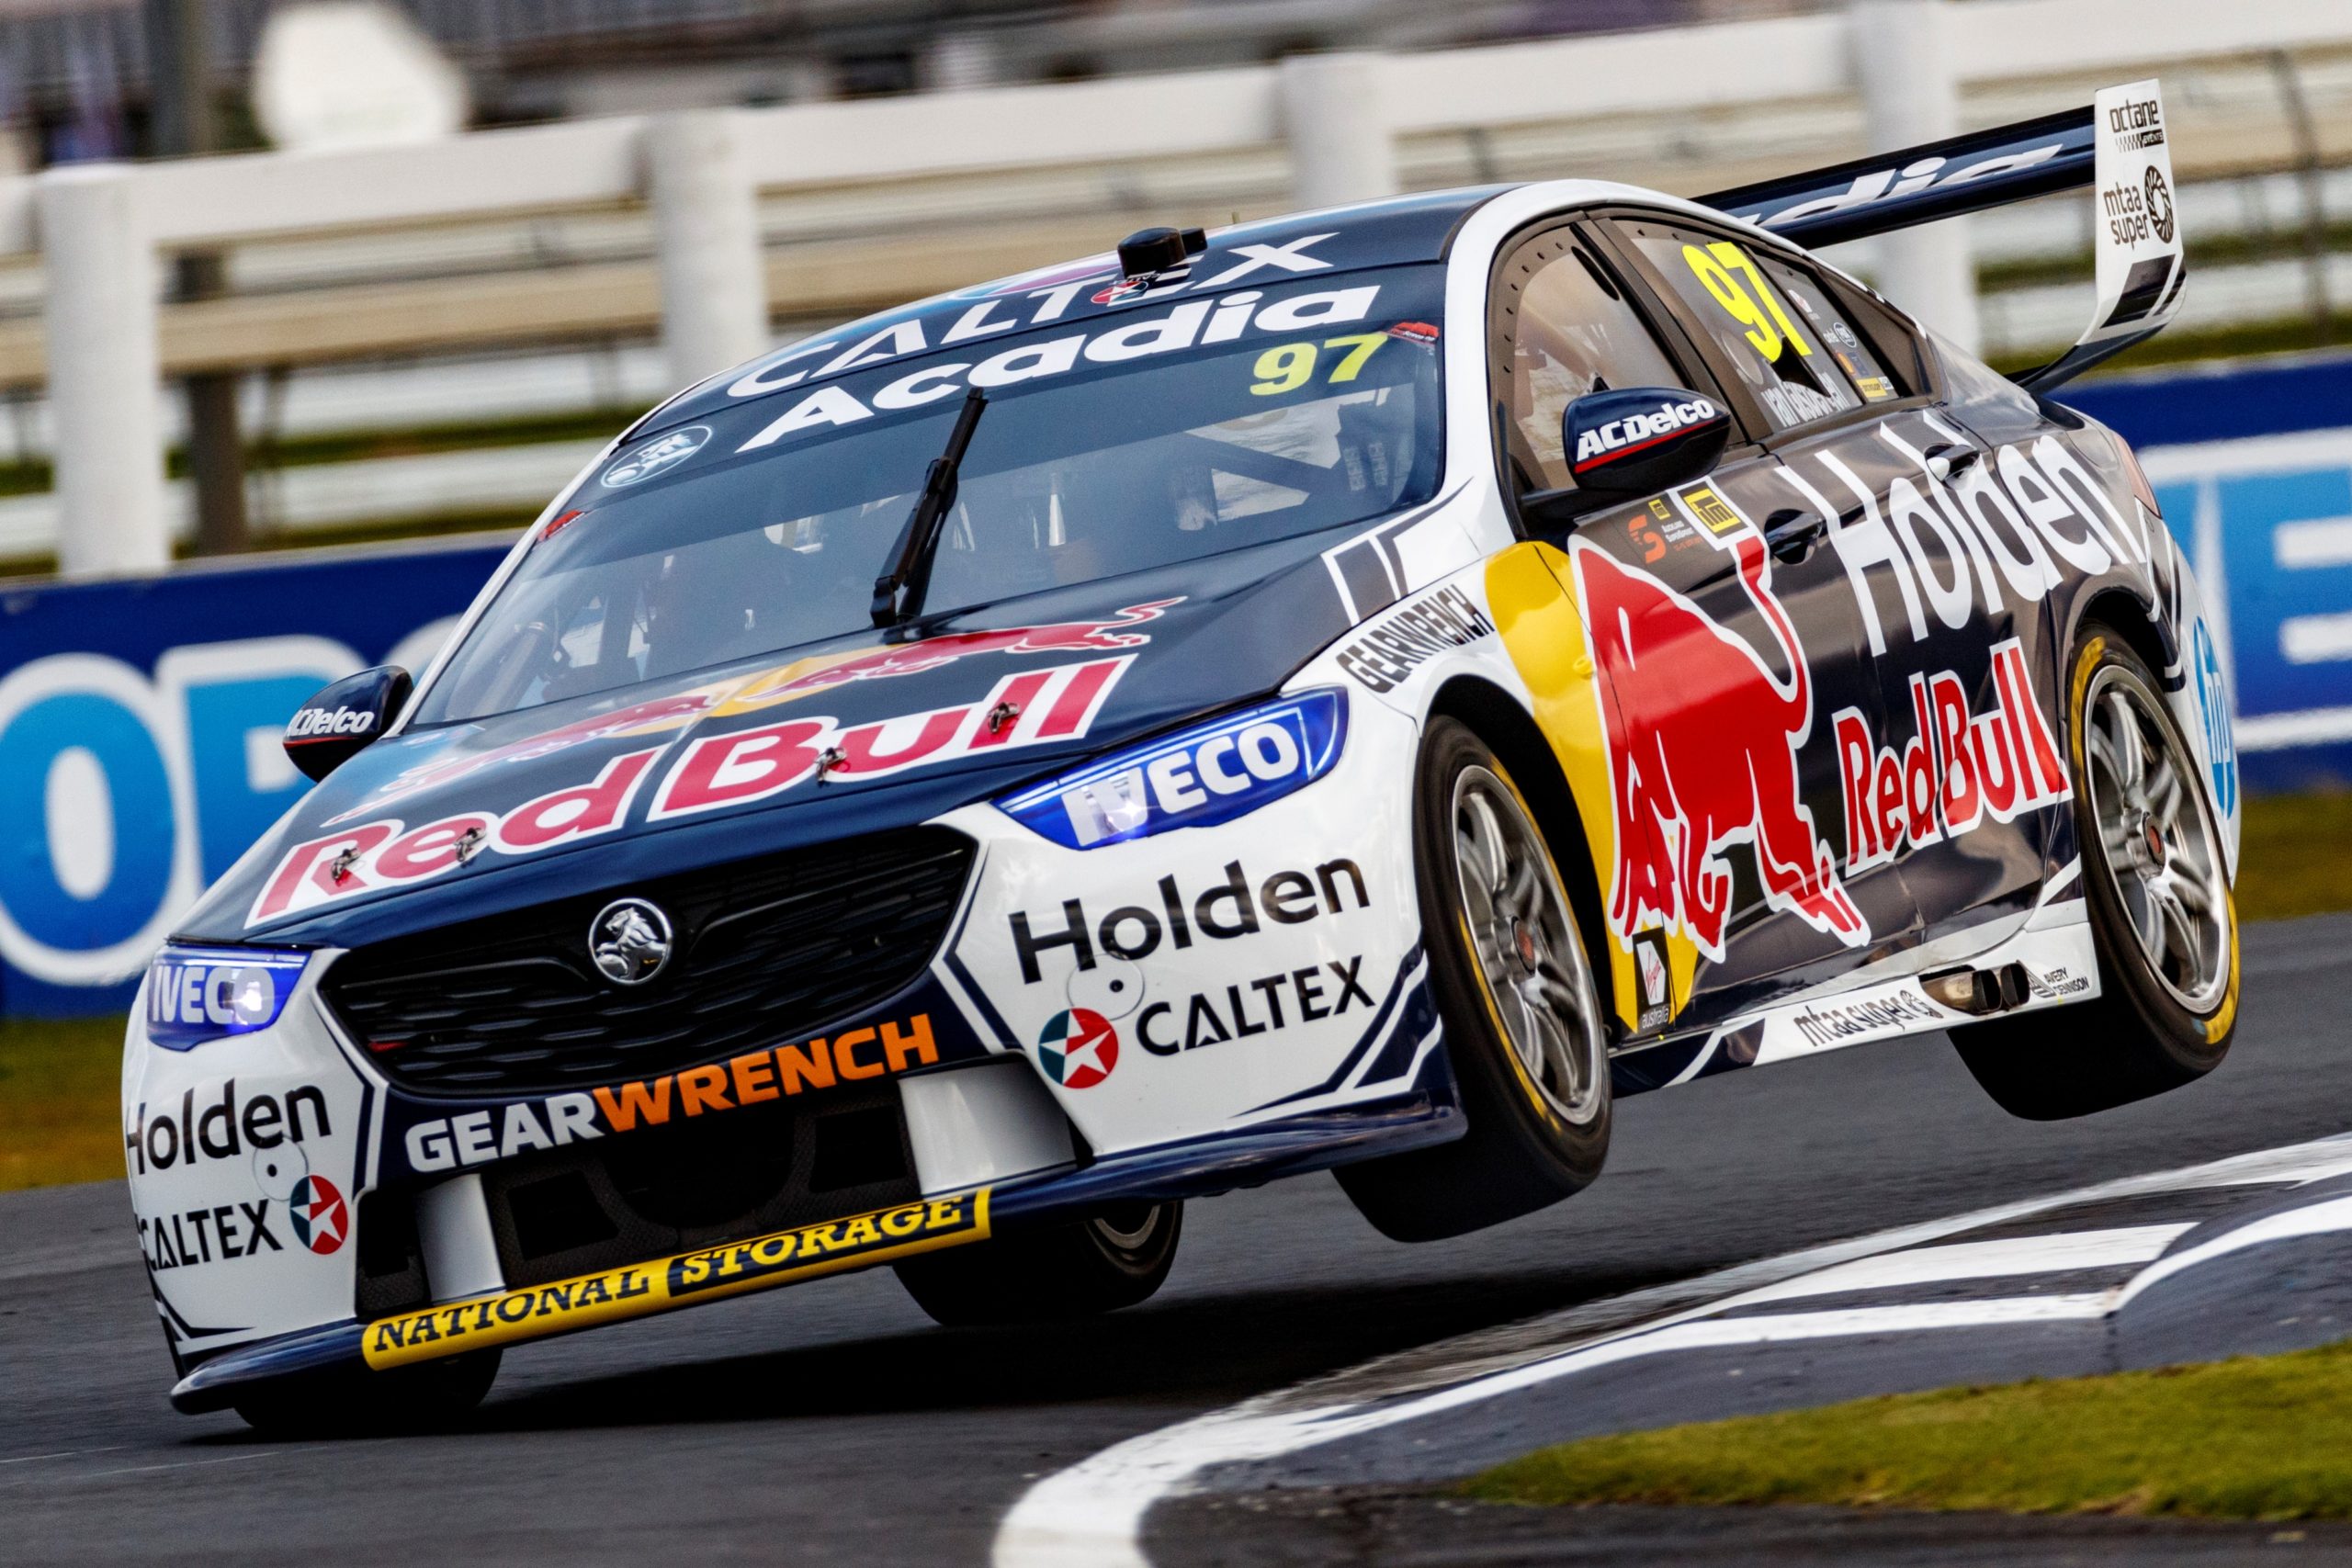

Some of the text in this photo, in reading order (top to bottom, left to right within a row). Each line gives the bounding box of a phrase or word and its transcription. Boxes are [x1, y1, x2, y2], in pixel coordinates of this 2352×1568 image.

[2109, 99, 2160, 133] octane
[2103, 182, 2143, 217] mtaa
[2110, 213, 2149, 250] super
[1682, 242, 1814, 363] 97
[734, 285, 1381, 453] Acadia
[1250, 333, 1388, 396] 97
[1577, 400, 1715, 462] ACDelco
[1774, 410, 2146, 658] Holden
[1336, 584, 1496, 694] GEARWRENCH
[244, 653, 1138, 930] Red Bull
[1060, 722, 1300, 847] IVECO
[1831, 636, 2075, 878] Red Bull
[1008, 857, 1371, 986] Holden
[2044, 967, 2069, 984] AVERY
[150, 965, 276, 1025] IVECO
[1136, 954, 1376, 1057] CALTEX
[404, 1013, 939, 1173] GEARWRENCH
[373, 1195, 963, 1353] NATIONAL STORAGE
